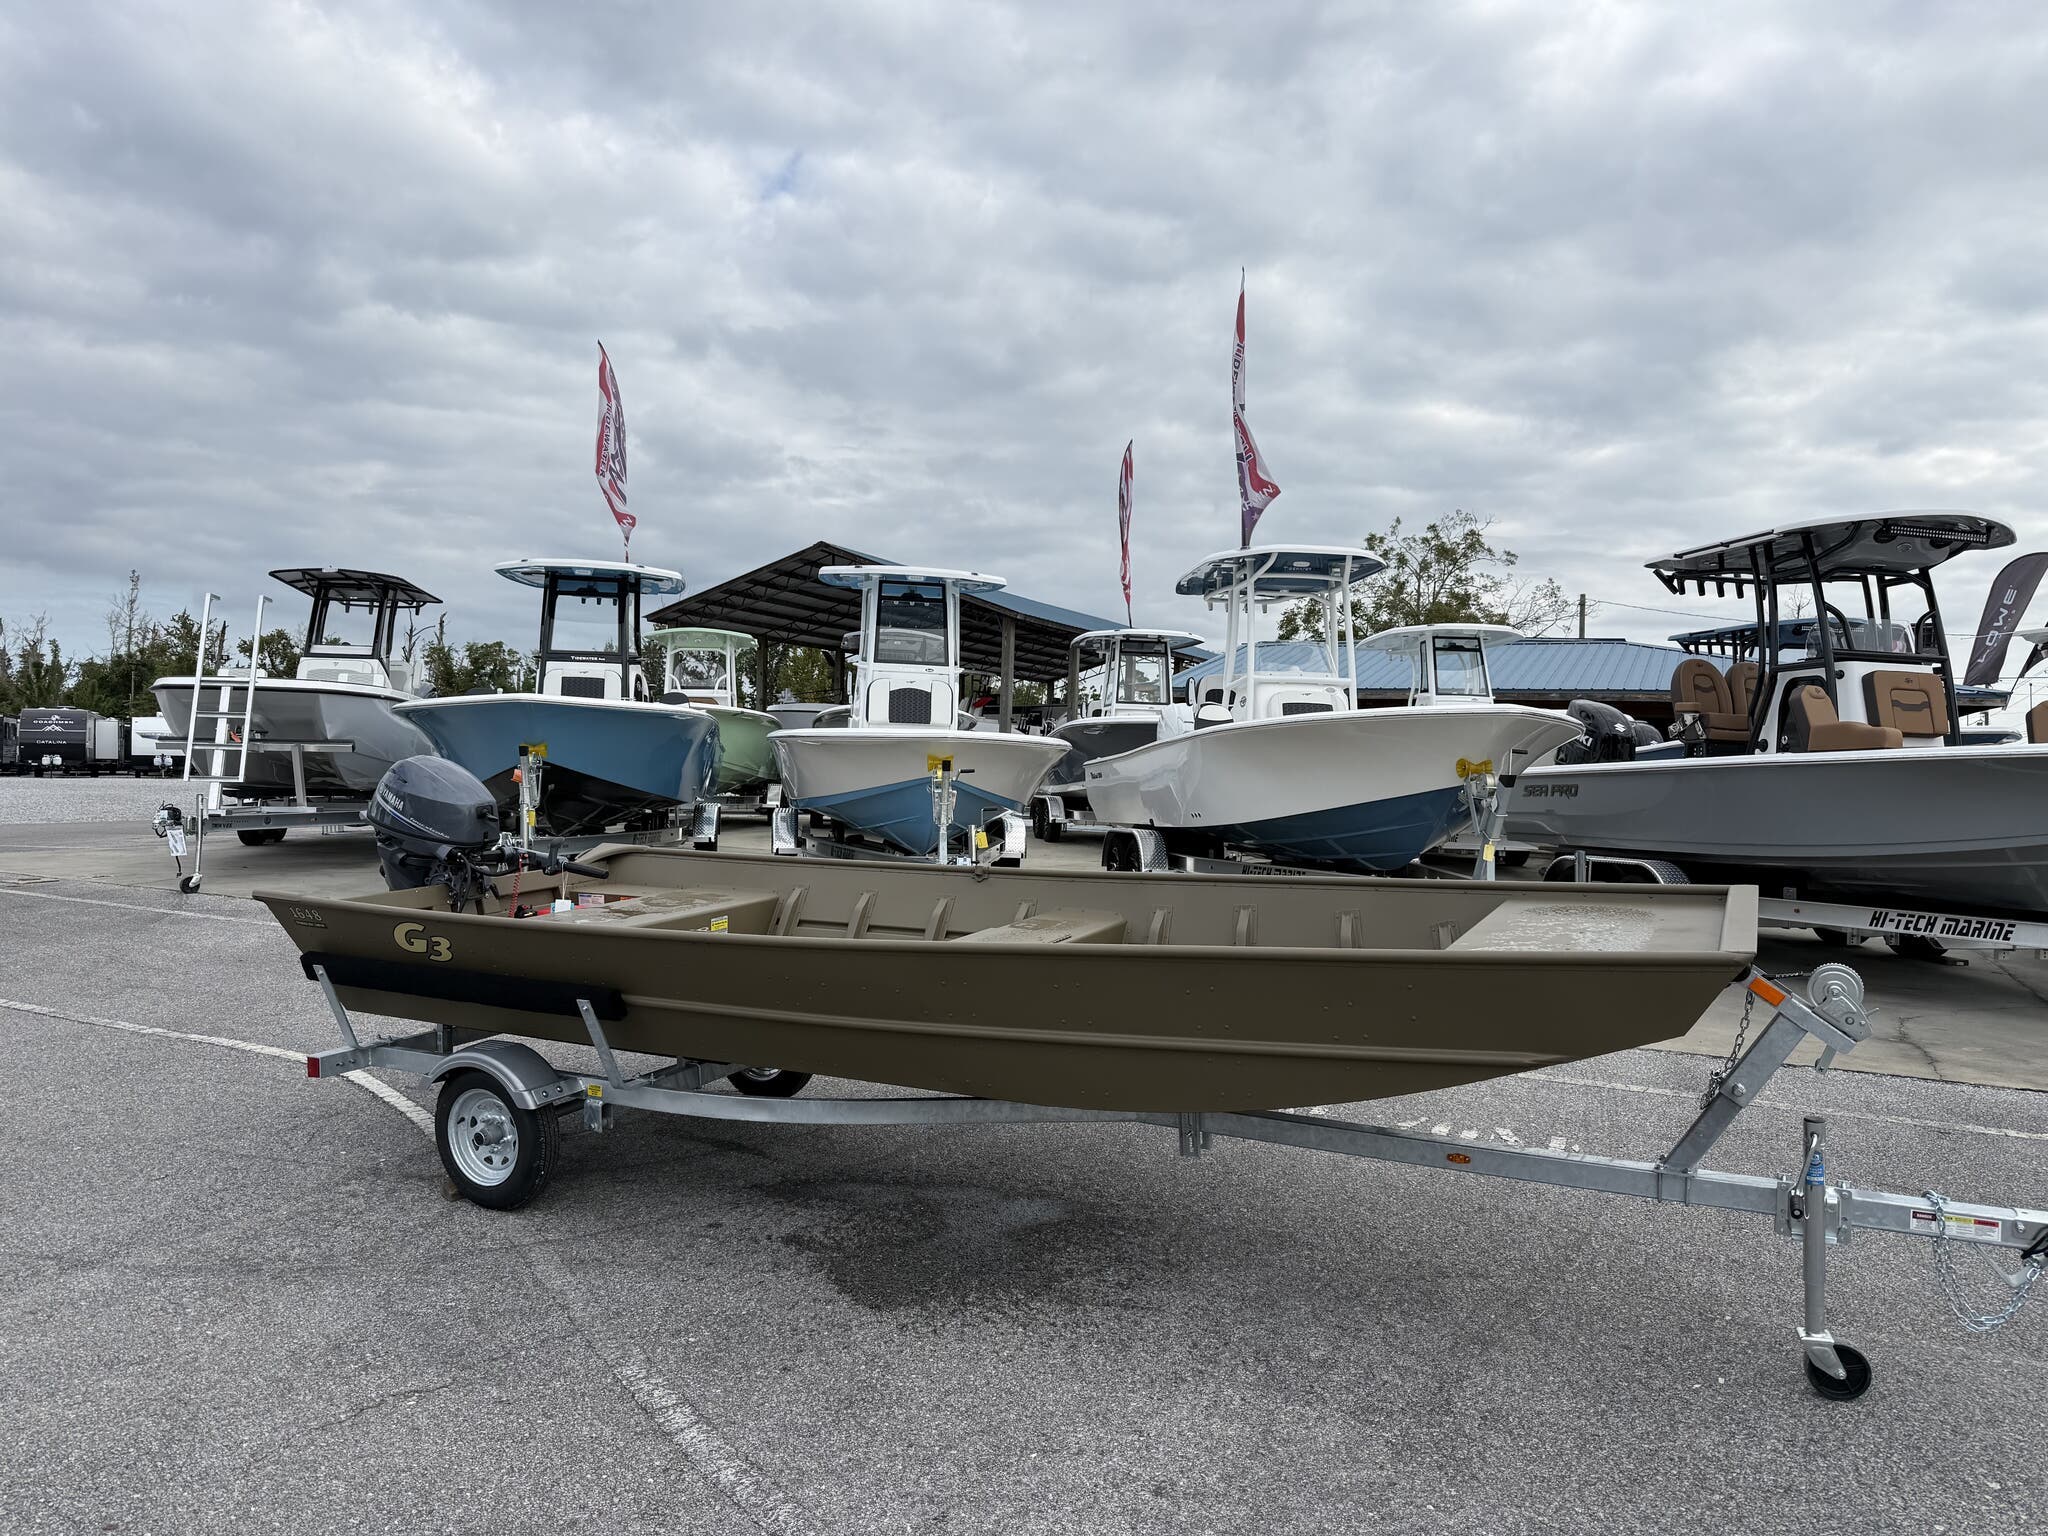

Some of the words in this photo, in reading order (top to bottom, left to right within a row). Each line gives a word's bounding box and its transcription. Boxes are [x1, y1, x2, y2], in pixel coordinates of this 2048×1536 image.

[599, 402, 613, 478] TIDEWATER
[1977, 588, 2018, 663] LOWE
[382, 788, 404, 812] YAMAHA
[1523, 784, 1549, 798] SEA
[1550, 784, 1579, 800] PRO
[289, 907, 322, 921] 1648
[1869, 910, 1938, 933] HI-TECH
[1939, 917, 2017, 942] MARINE
[393, 921, 453, 962] G3
